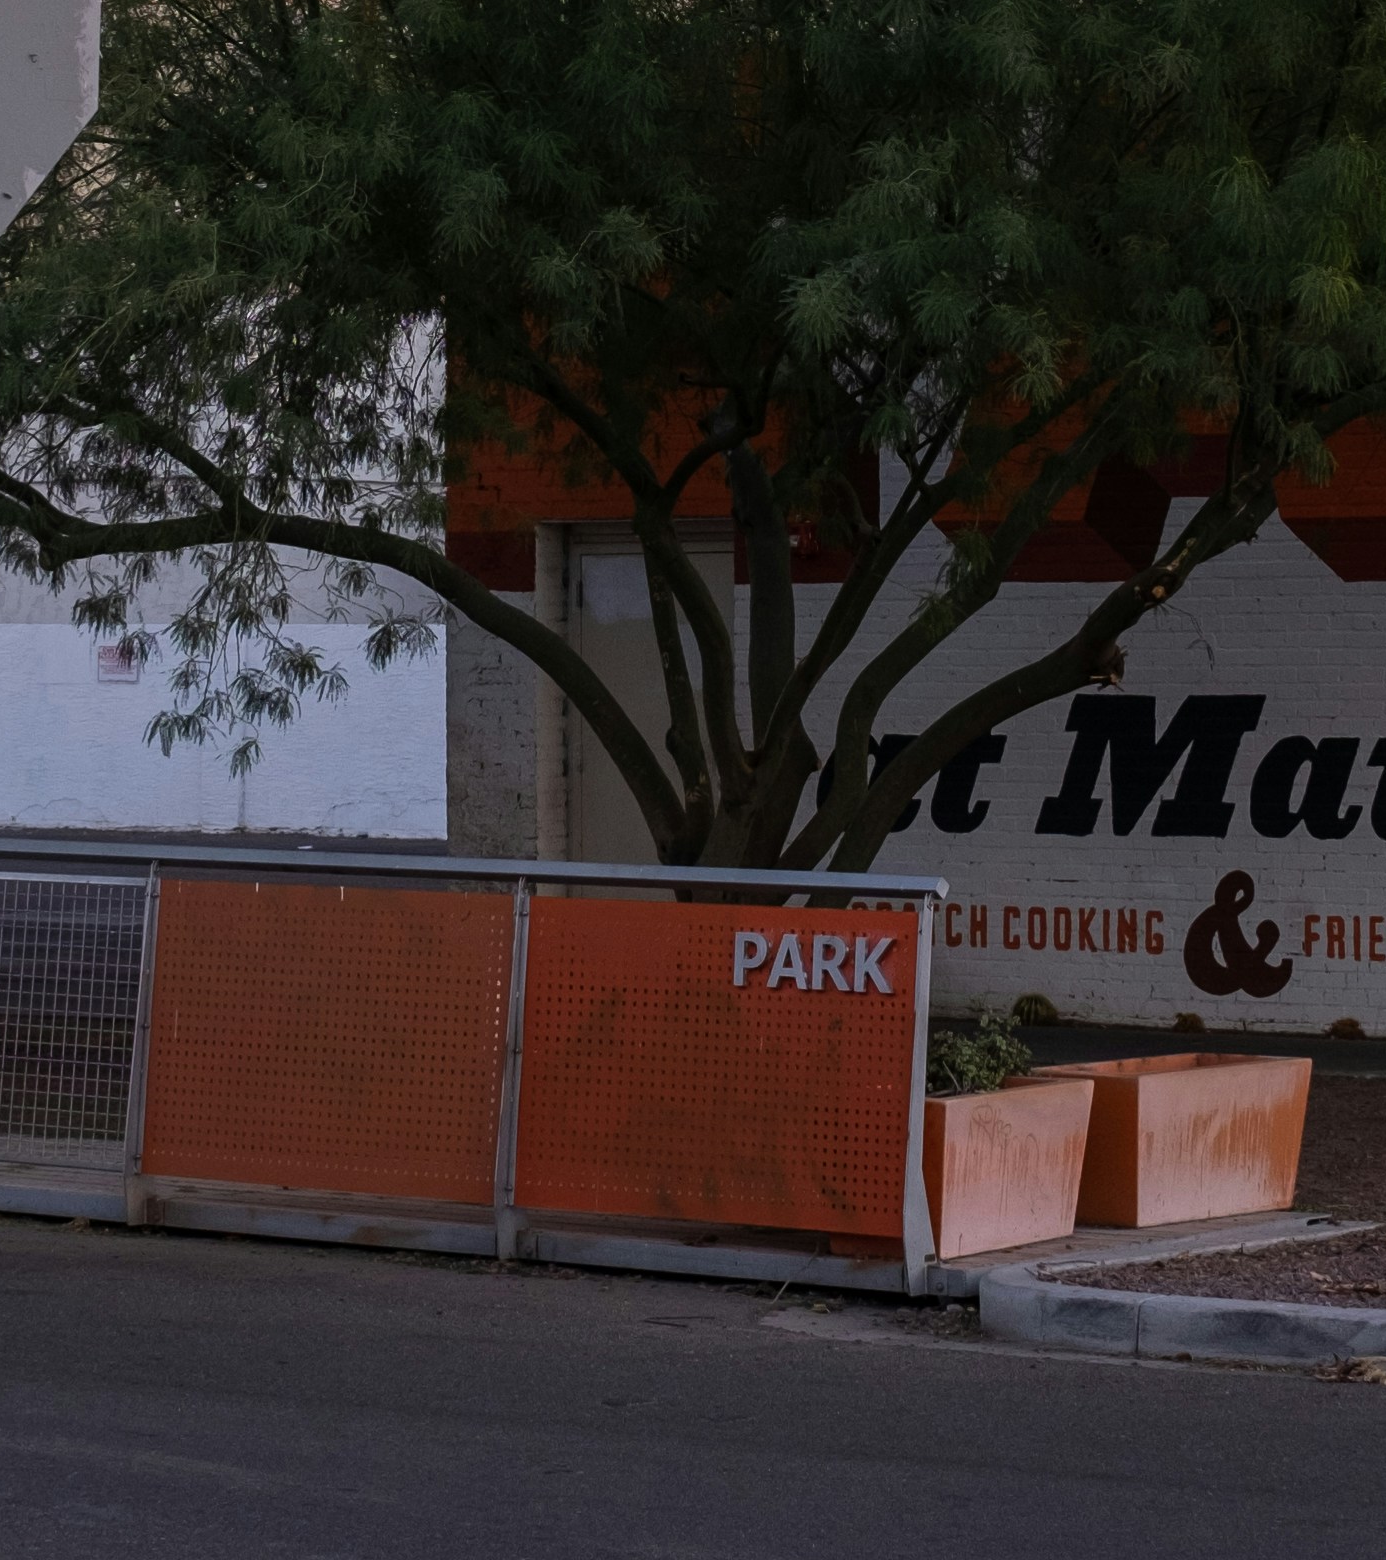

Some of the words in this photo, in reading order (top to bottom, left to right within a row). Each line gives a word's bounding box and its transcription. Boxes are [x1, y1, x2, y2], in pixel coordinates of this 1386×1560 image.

[732, 931, 894, 993] PARK
[1002, 905, 1165, 955] COOKING
[1183, 869, 1293, 998] &
